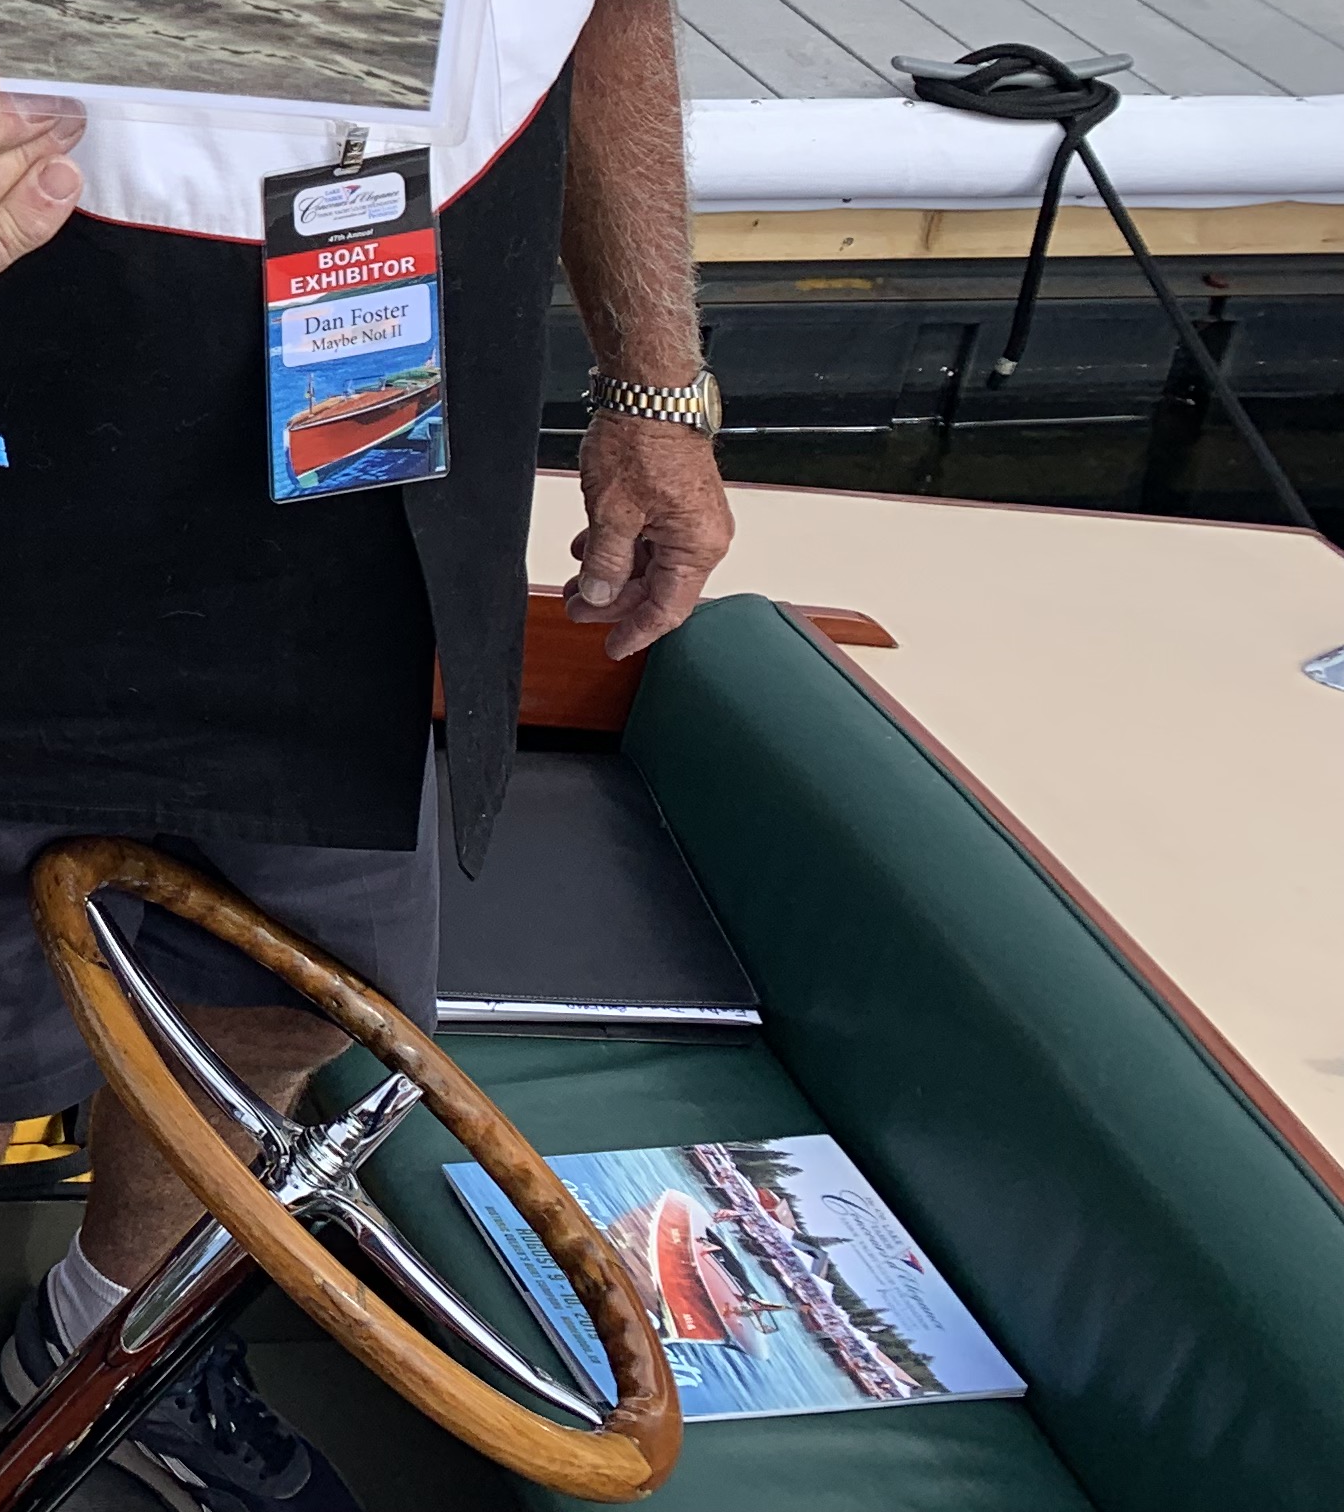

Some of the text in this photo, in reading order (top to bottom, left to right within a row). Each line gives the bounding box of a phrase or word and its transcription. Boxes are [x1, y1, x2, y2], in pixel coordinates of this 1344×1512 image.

[318, 243, 379, 270] BOAT
[290, 257, 416, 295] EXHIBITOR
[304, 303, 410, 336] Dan Foster
[311, 325, 403, 354] Maybe Not II
[515, 1228, 559, 1269] AUGUST
[547, 1272, 567, 1282] 9
